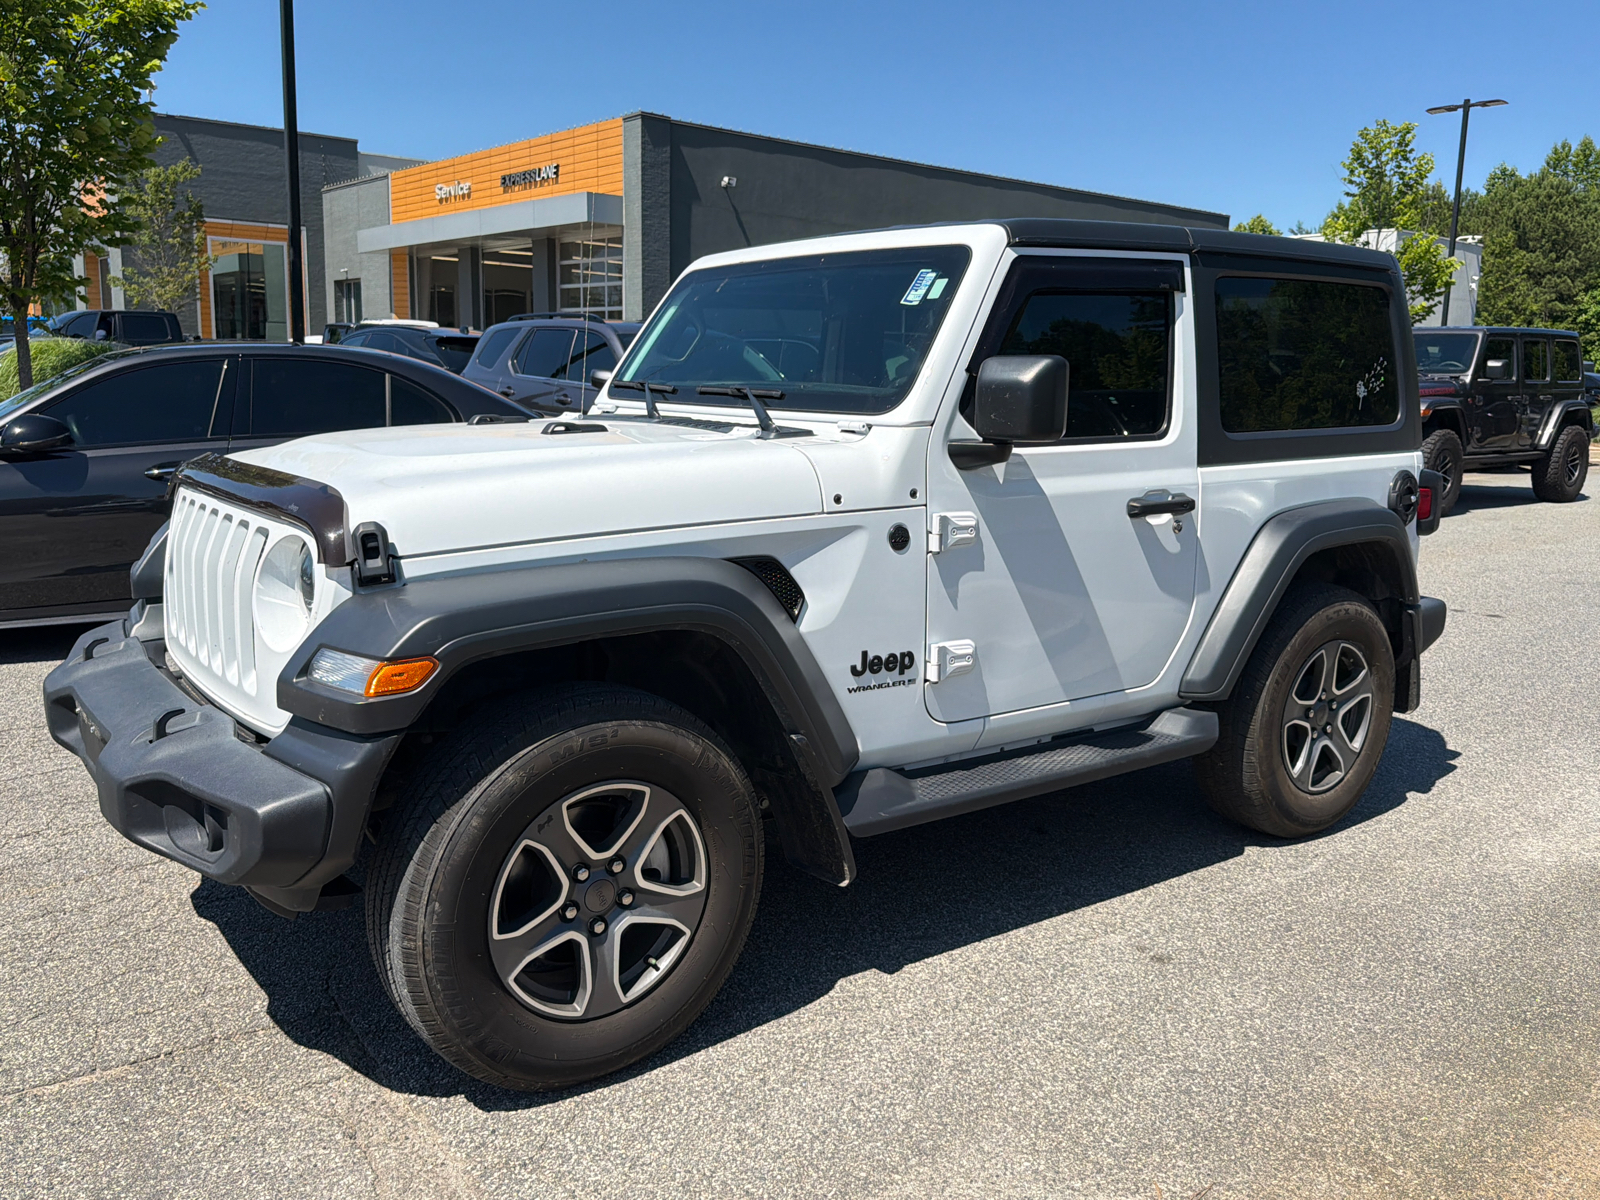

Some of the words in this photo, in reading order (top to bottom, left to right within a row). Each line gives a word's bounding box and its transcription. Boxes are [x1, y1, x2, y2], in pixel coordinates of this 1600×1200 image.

[435, 180, 471, 199] Service
[850, 650, 915, 677] Jeep
[847, 680, 906, 694] WRANGLER
